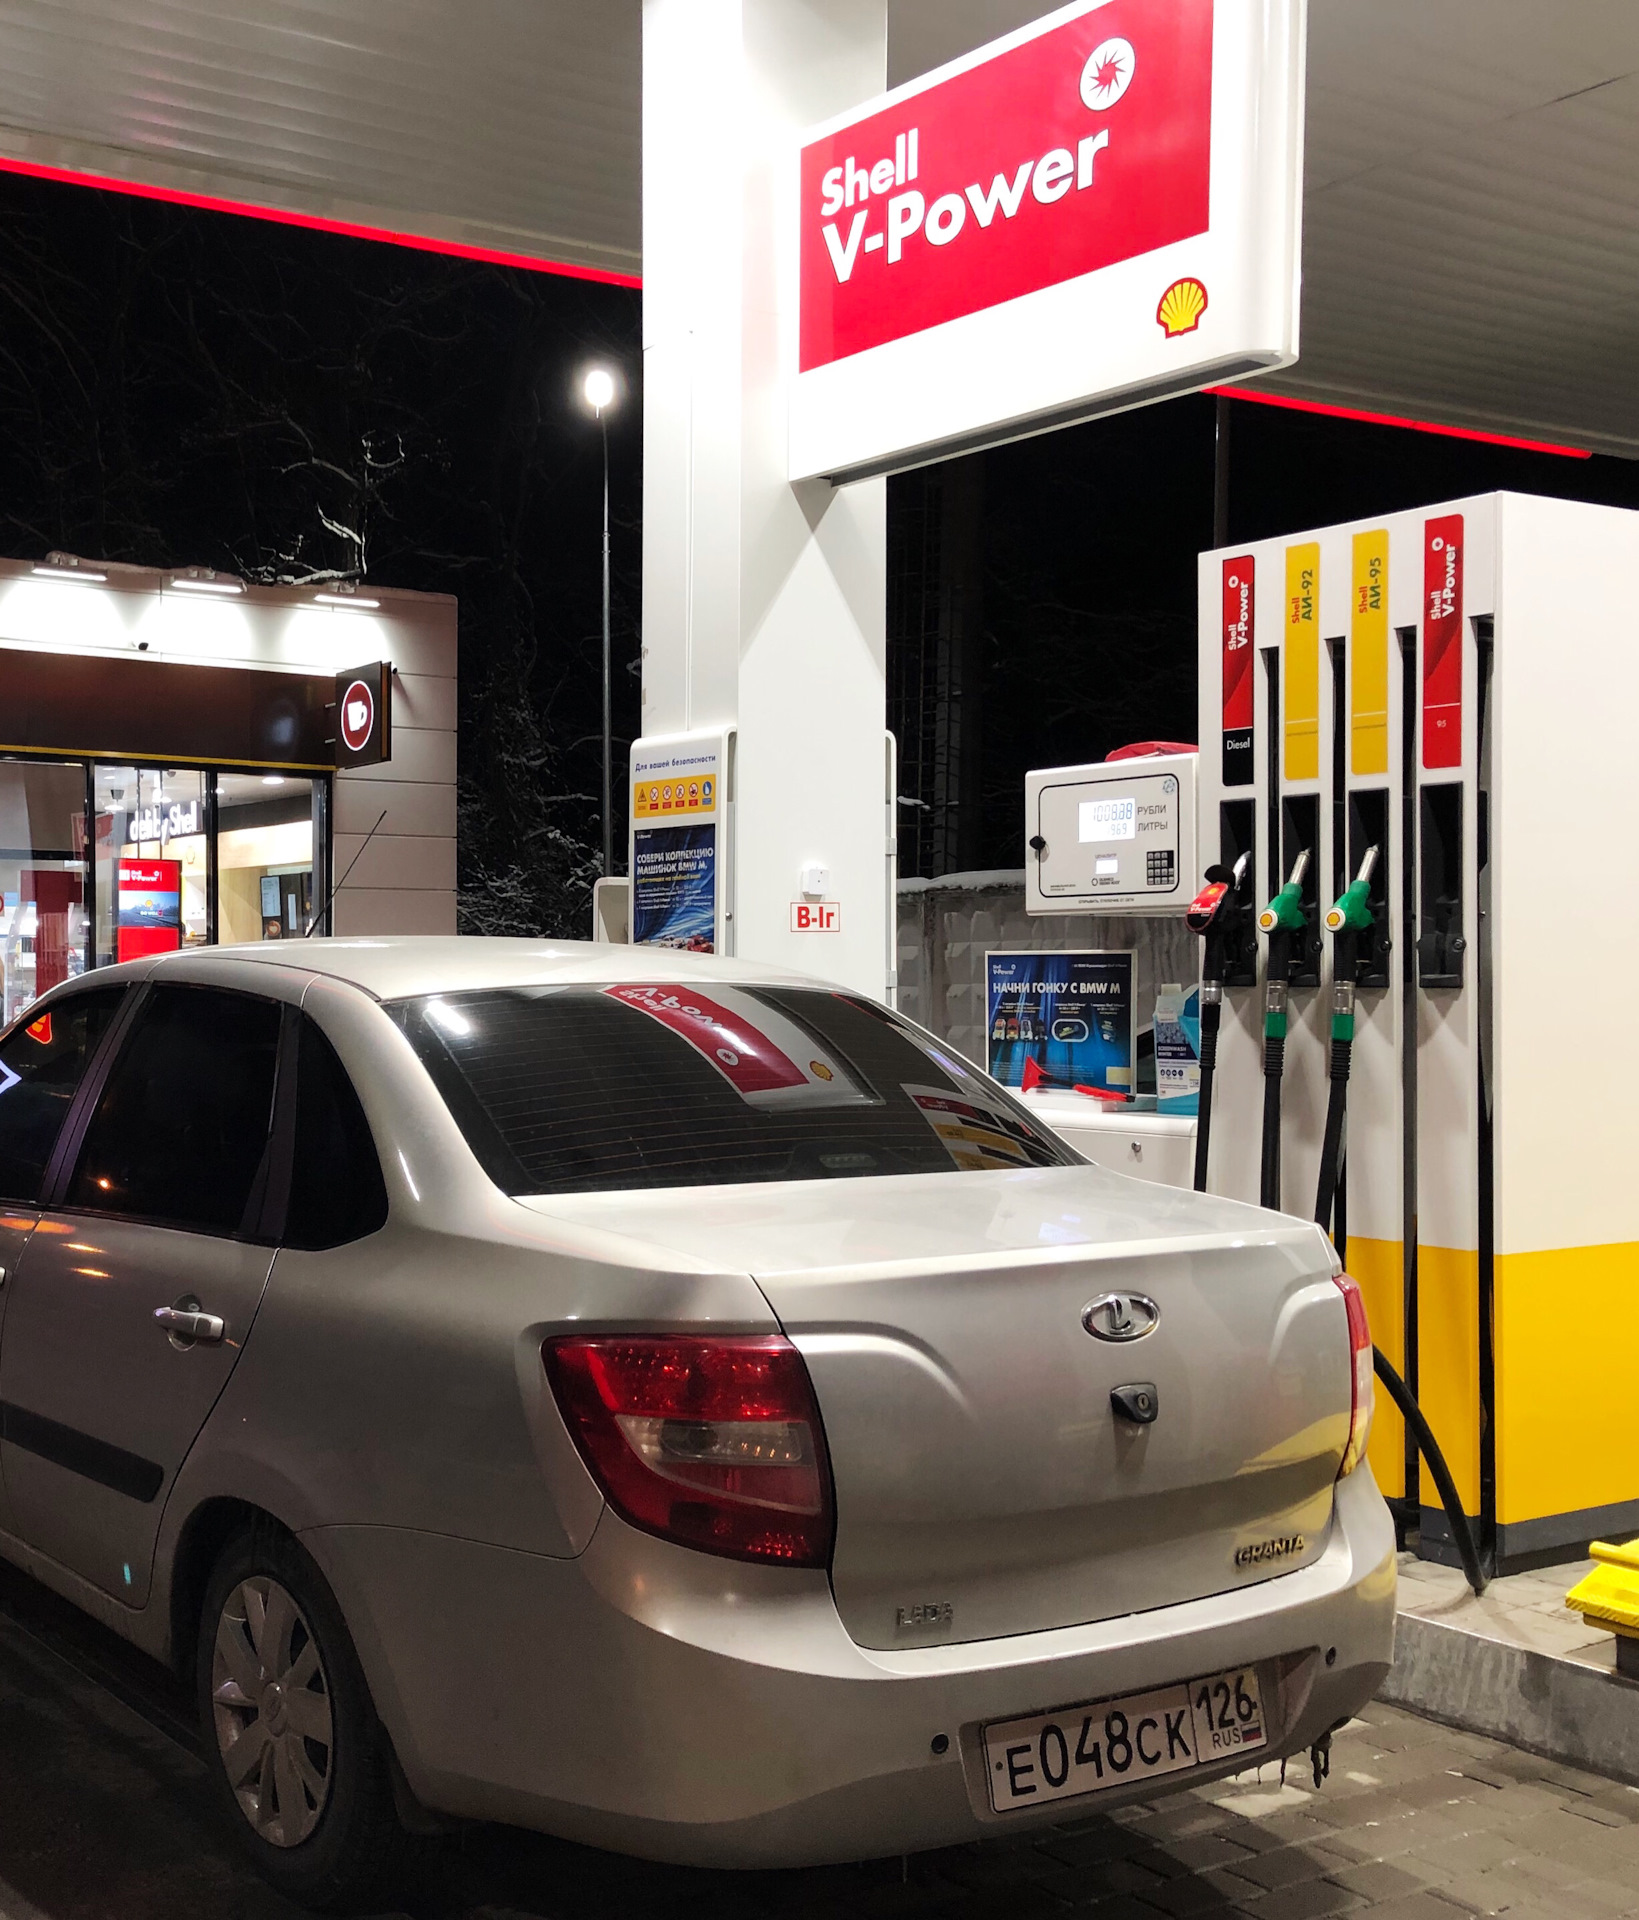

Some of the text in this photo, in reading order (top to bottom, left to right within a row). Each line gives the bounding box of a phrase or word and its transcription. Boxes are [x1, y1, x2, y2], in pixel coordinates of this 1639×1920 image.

[821, 127, 918, 216] Shell
[821, 128, 1109, 284] V-Power
[1369, 557, 1381, 610] АИ-95
[1442, 544, 1456, 617] V-Power
[1301, 569, 1313, 620] АИ-92
[1359, 586, 1368, 613] Shell
[1431, 590, 1441, 620] Shell
[1237, 581, 1249, 649] V-Power
[1292, 597, 1300, 624] Shell
[1228, 624, 1237, 650] Shell
[1226, 737, 1250, 750] Diesel
[635, 755, 716, 772] Для вашей безопасности
[169, 800, 197, 836] Shell
[1137, 805, 1167, 815] РУБЛИ
[1137, 821, 1168, 832] ЛИТРЫ
[637, 847, 714, 864] СОБЕРИ КОЛЛЕКЦИЮ
[637, 863, 677, 875] МАШИНОК
[992, 982, 1120, 994] НАЧНИ ГОНКУ С BMW M
[1234, 1534, 1305, 1569] GRANTA
[896, 1601, 954, 1626] LADA
[1196, 1674, 1254, 1732] 126
[1212, 1731, 1241, 1749] RUS
